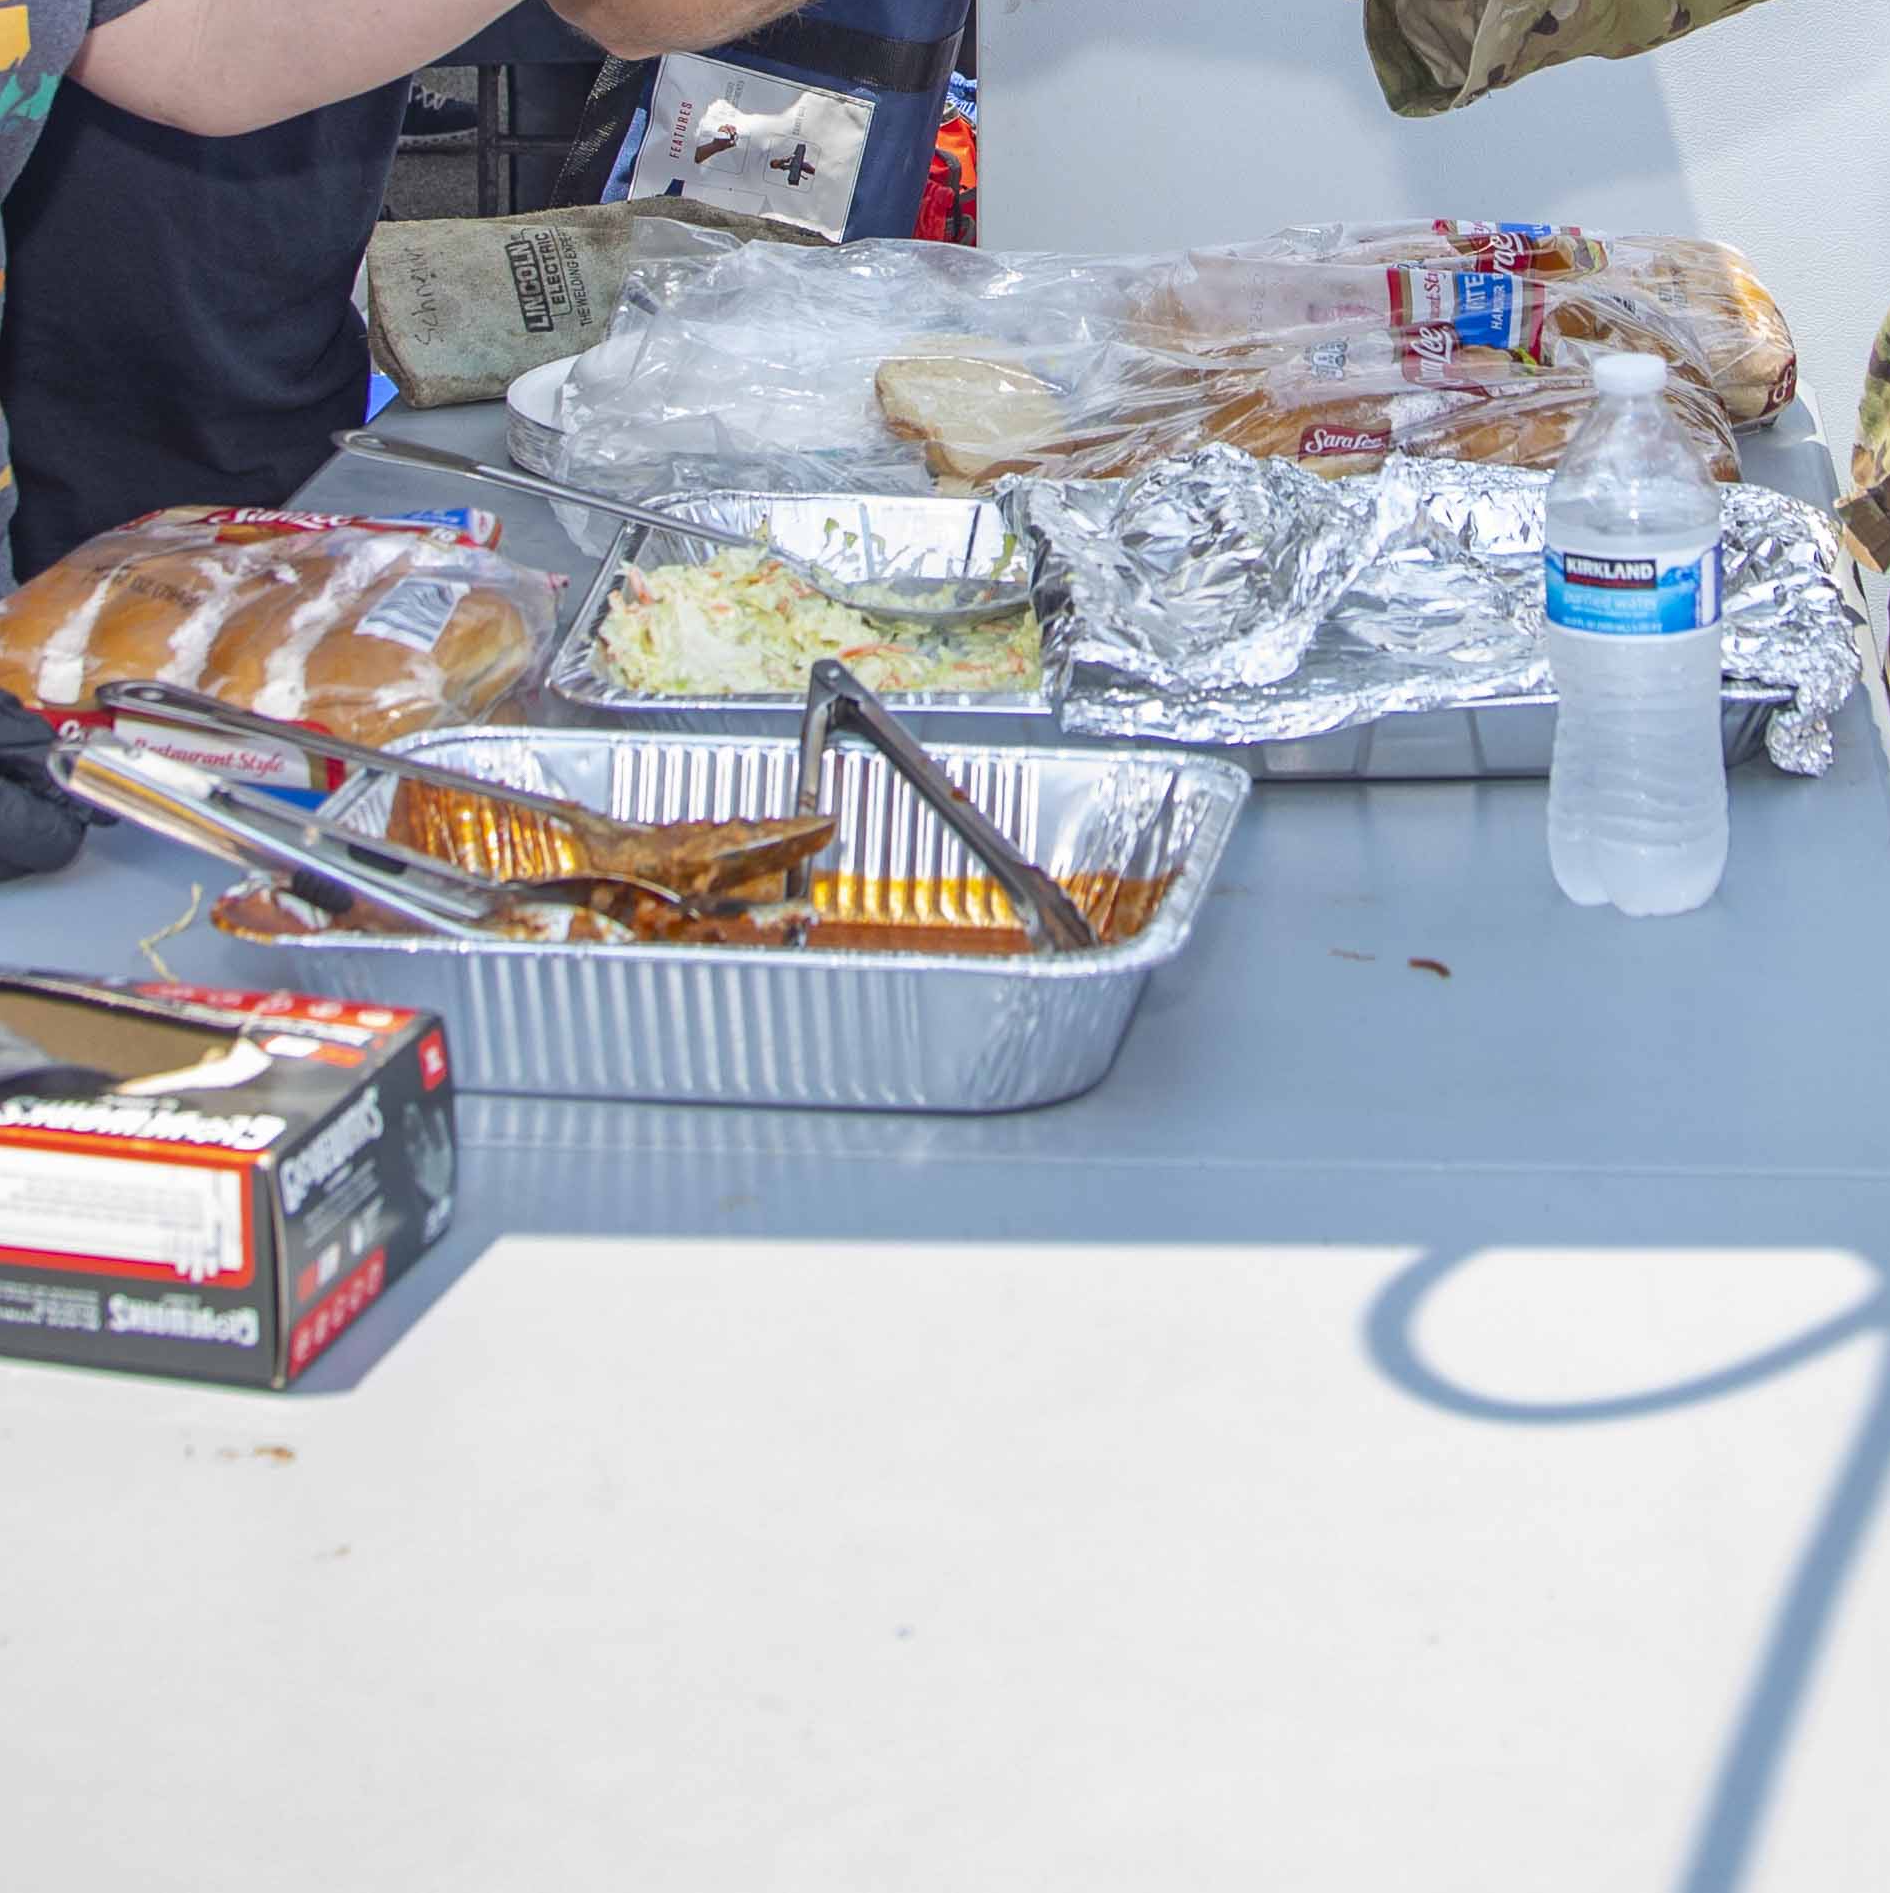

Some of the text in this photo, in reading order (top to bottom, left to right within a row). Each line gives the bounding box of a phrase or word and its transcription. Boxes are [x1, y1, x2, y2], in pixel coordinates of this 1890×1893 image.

[670, 100, 694, 161] FEATURES
[506, 240, 553, 331] LINCOLN
[535, 231, 566, 305] ELECTRIC
[567, 260, 590, 309] WELDING
[1565, 560, 1655, 584] KIRKLAND
[238, 751, 287, 776] Style
